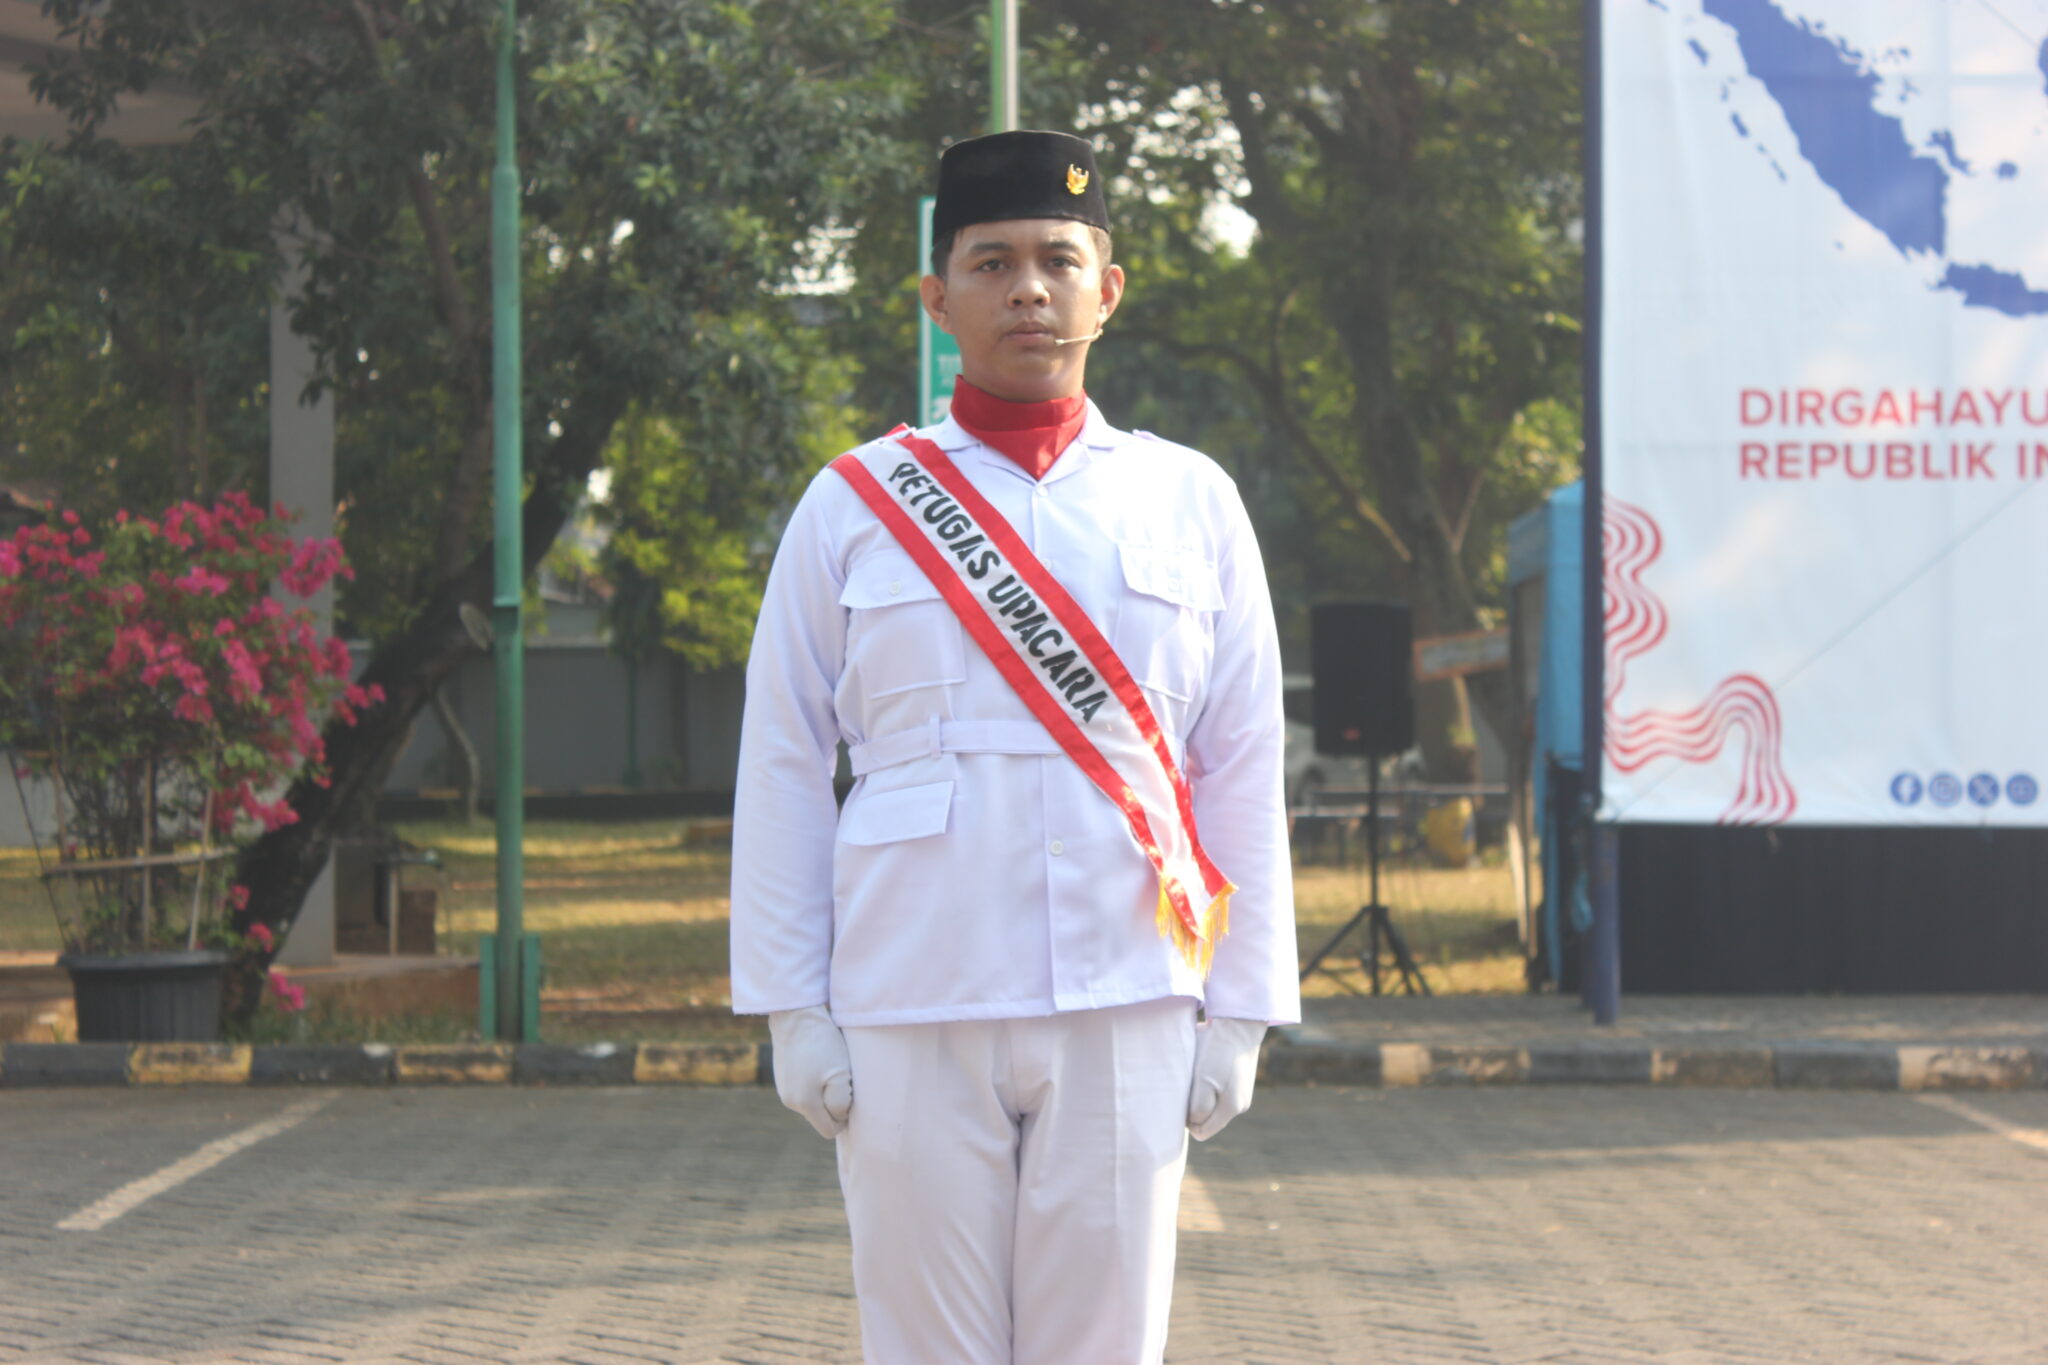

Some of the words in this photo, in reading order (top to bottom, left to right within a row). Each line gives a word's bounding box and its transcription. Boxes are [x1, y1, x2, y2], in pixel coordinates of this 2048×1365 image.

[1740, 388, 2048, 425] DIRGAHAYU
[1740, 442, 1996, 479] REPUBLIK
[888, 462, 1000, 580] PETUGAS
[987, 574, 1108, 723] UPACARA
